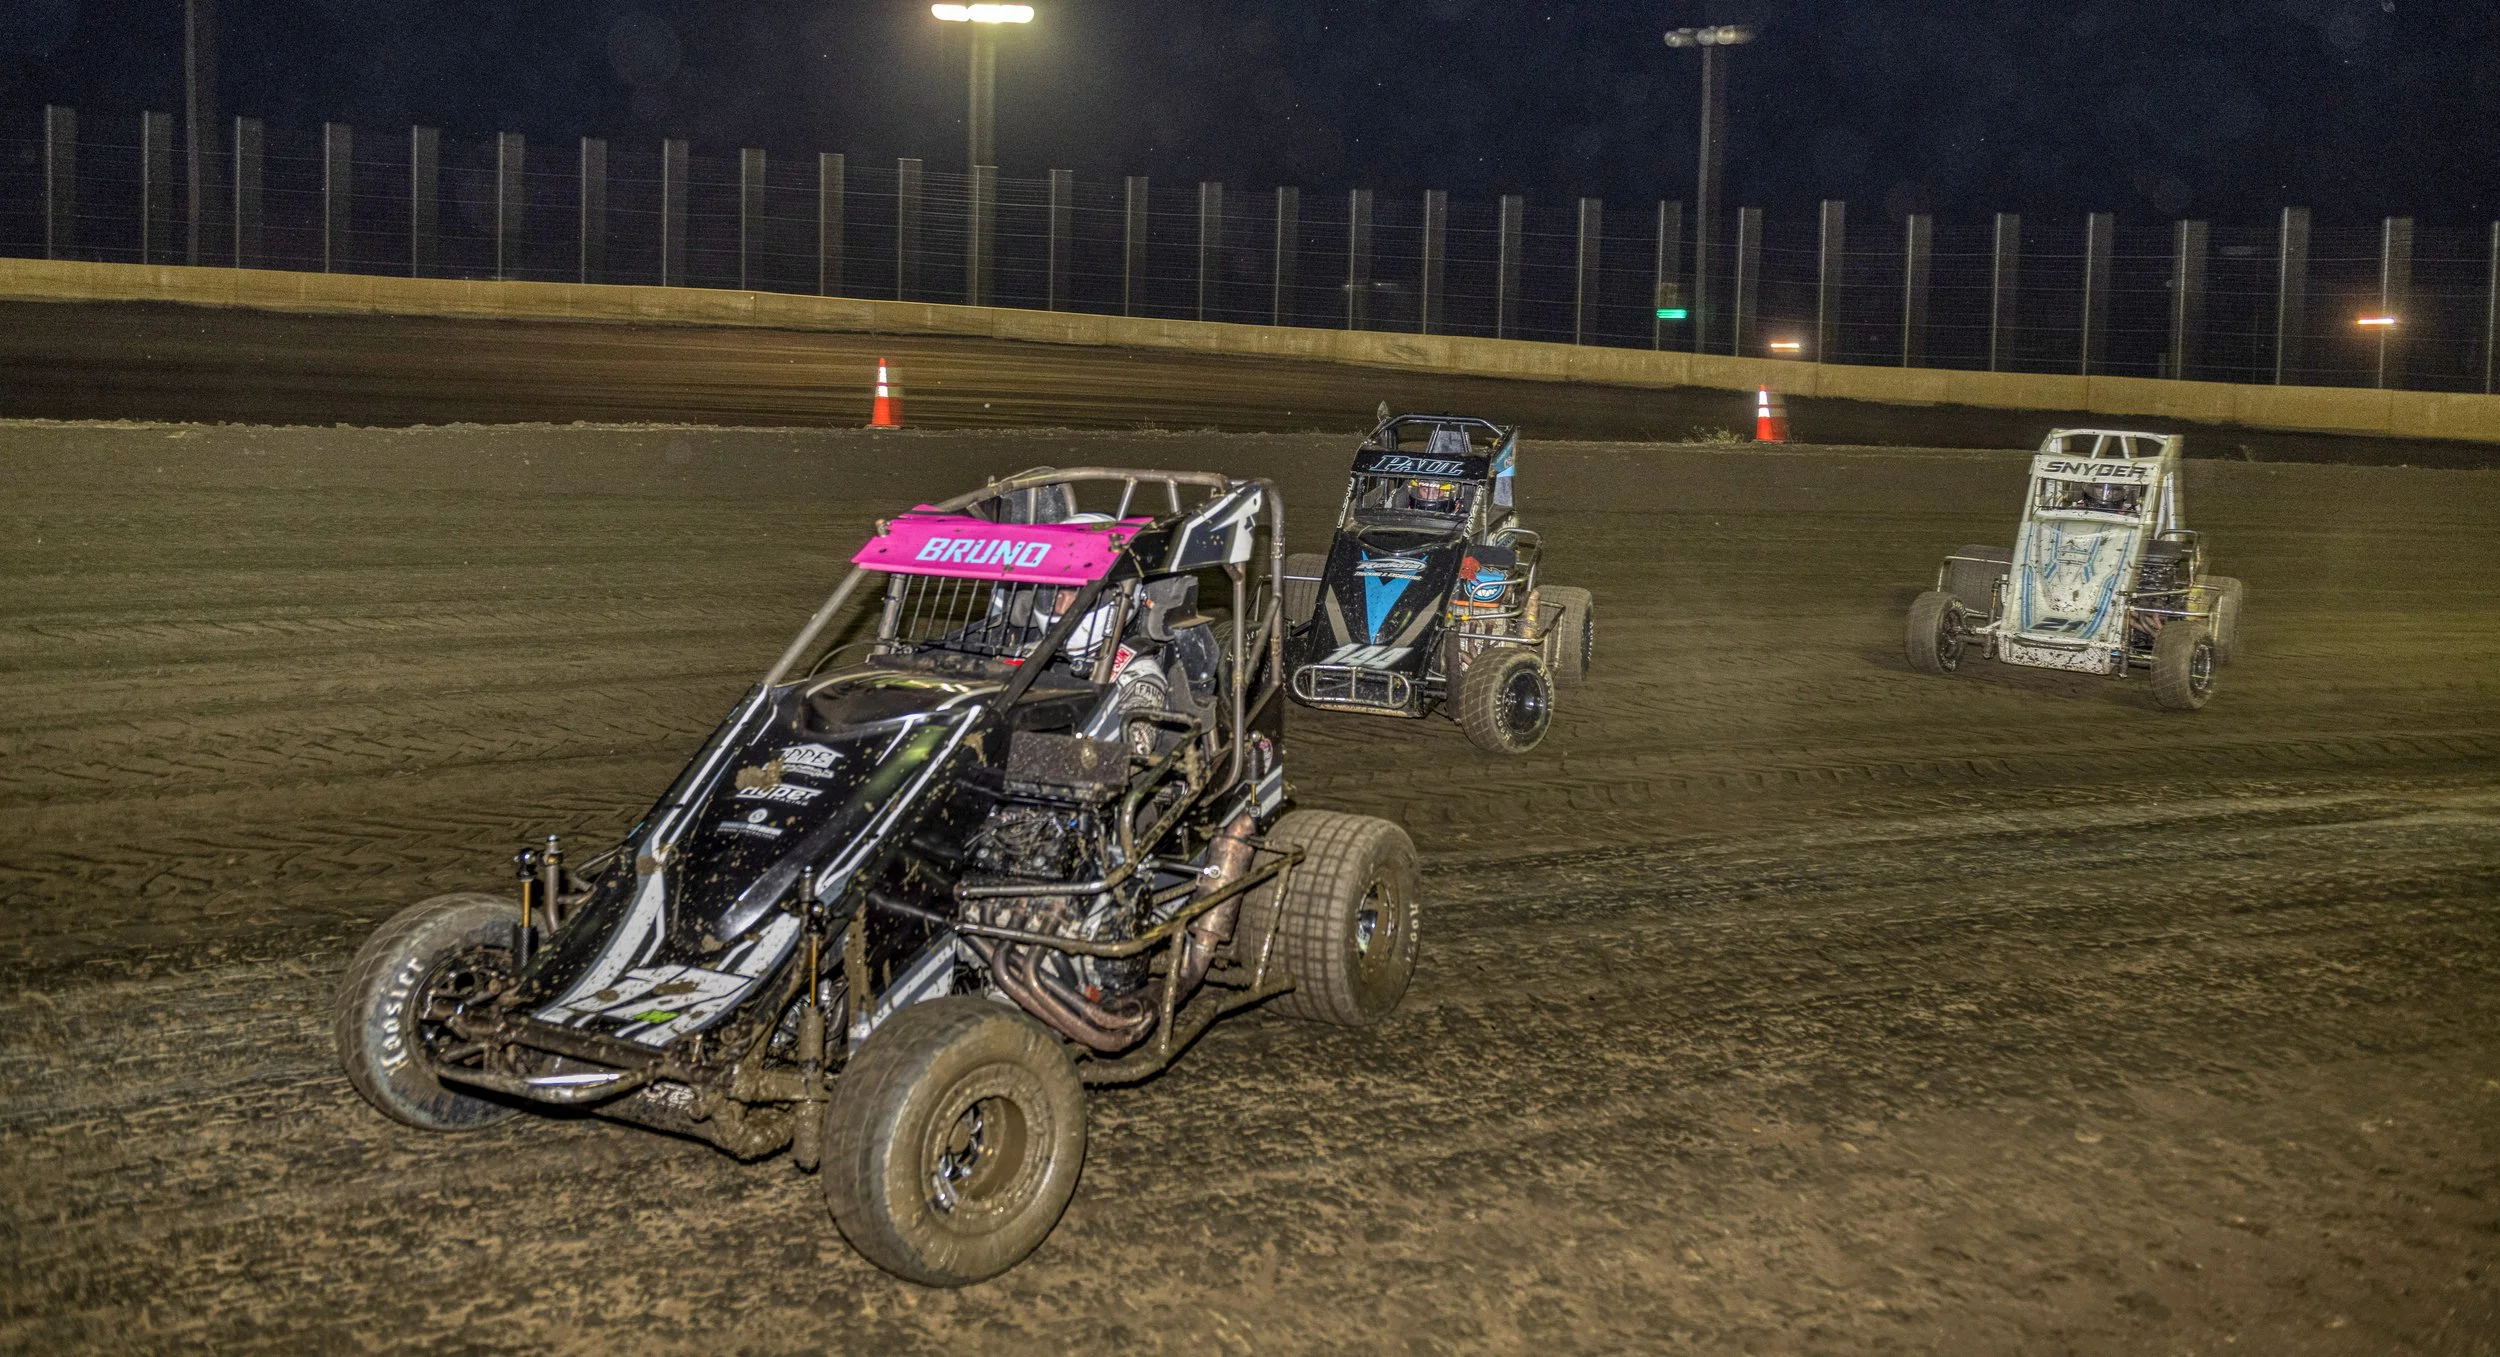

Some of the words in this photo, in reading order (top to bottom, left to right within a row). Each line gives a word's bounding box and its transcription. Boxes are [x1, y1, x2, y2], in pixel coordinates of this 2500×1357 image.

[1368, 454, 1465, 476] PAUL
[2044, 461, 2148, 479] SNYDER
[915, 537, 1052, 568] BRUNO
